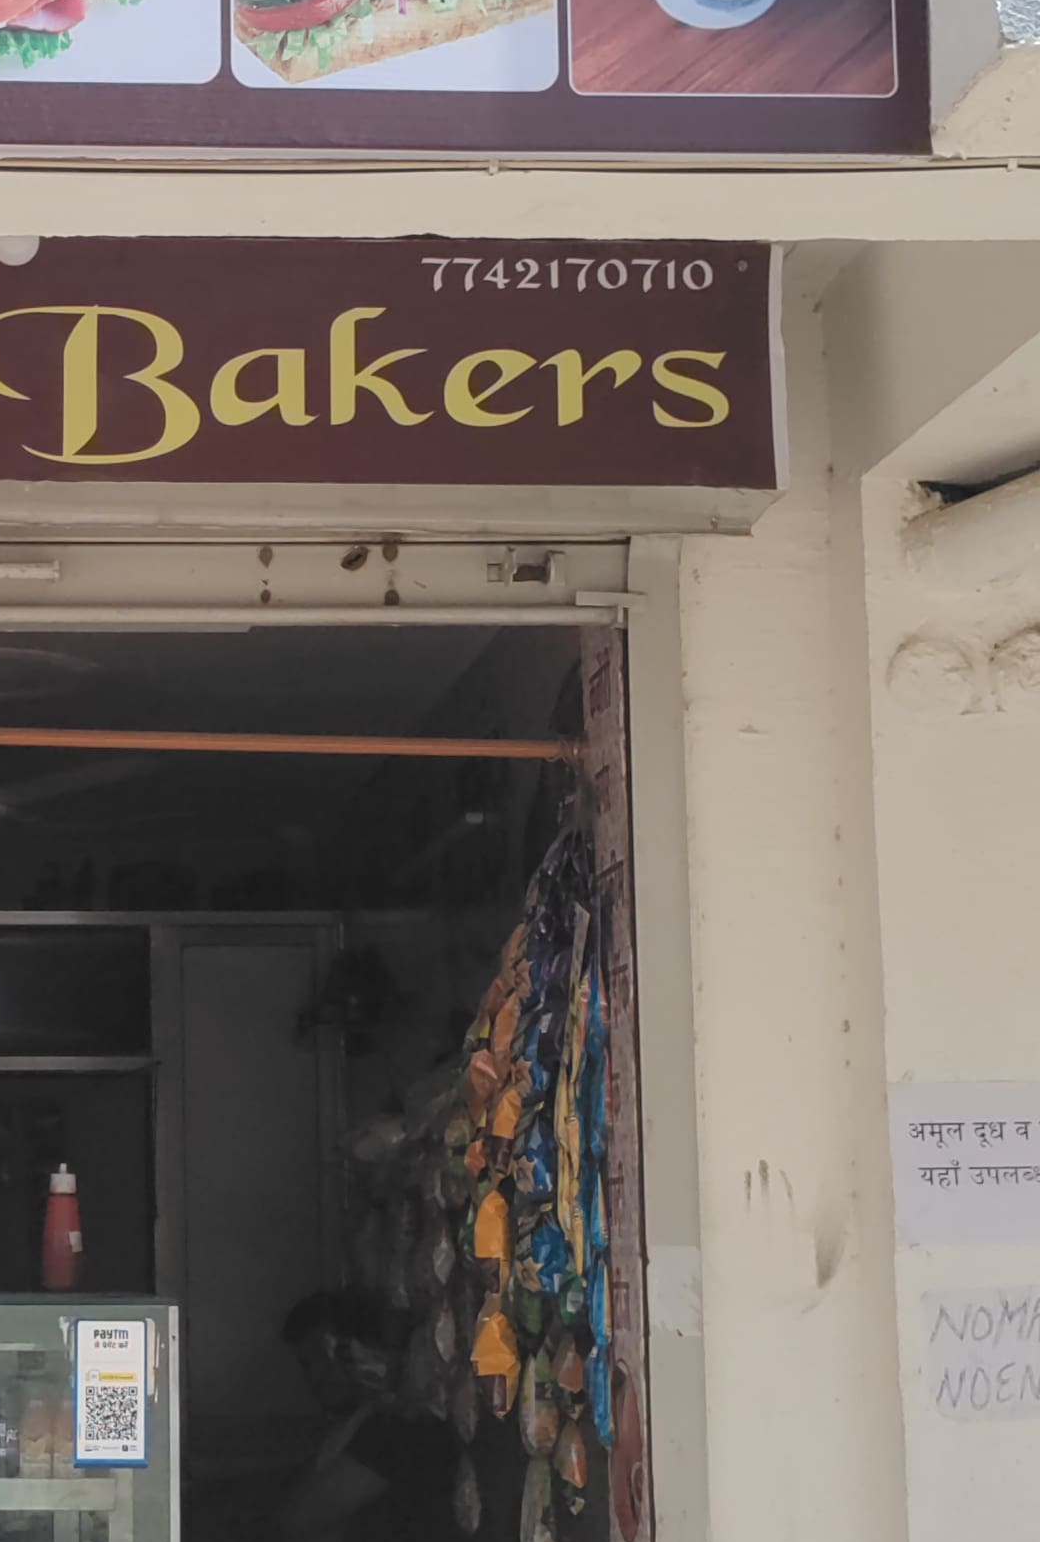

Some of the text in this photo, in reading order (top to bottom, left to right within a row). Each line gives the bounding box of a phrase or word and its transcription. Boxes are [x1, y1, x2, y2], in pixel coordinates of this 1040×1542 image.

[421, 258, 713, 292] 7742170710
[909, 1122, 965, 1149] अमूल
[972, 1121, 1007, 1148] दूध
[1014, 1121, 1032, 1140] व
